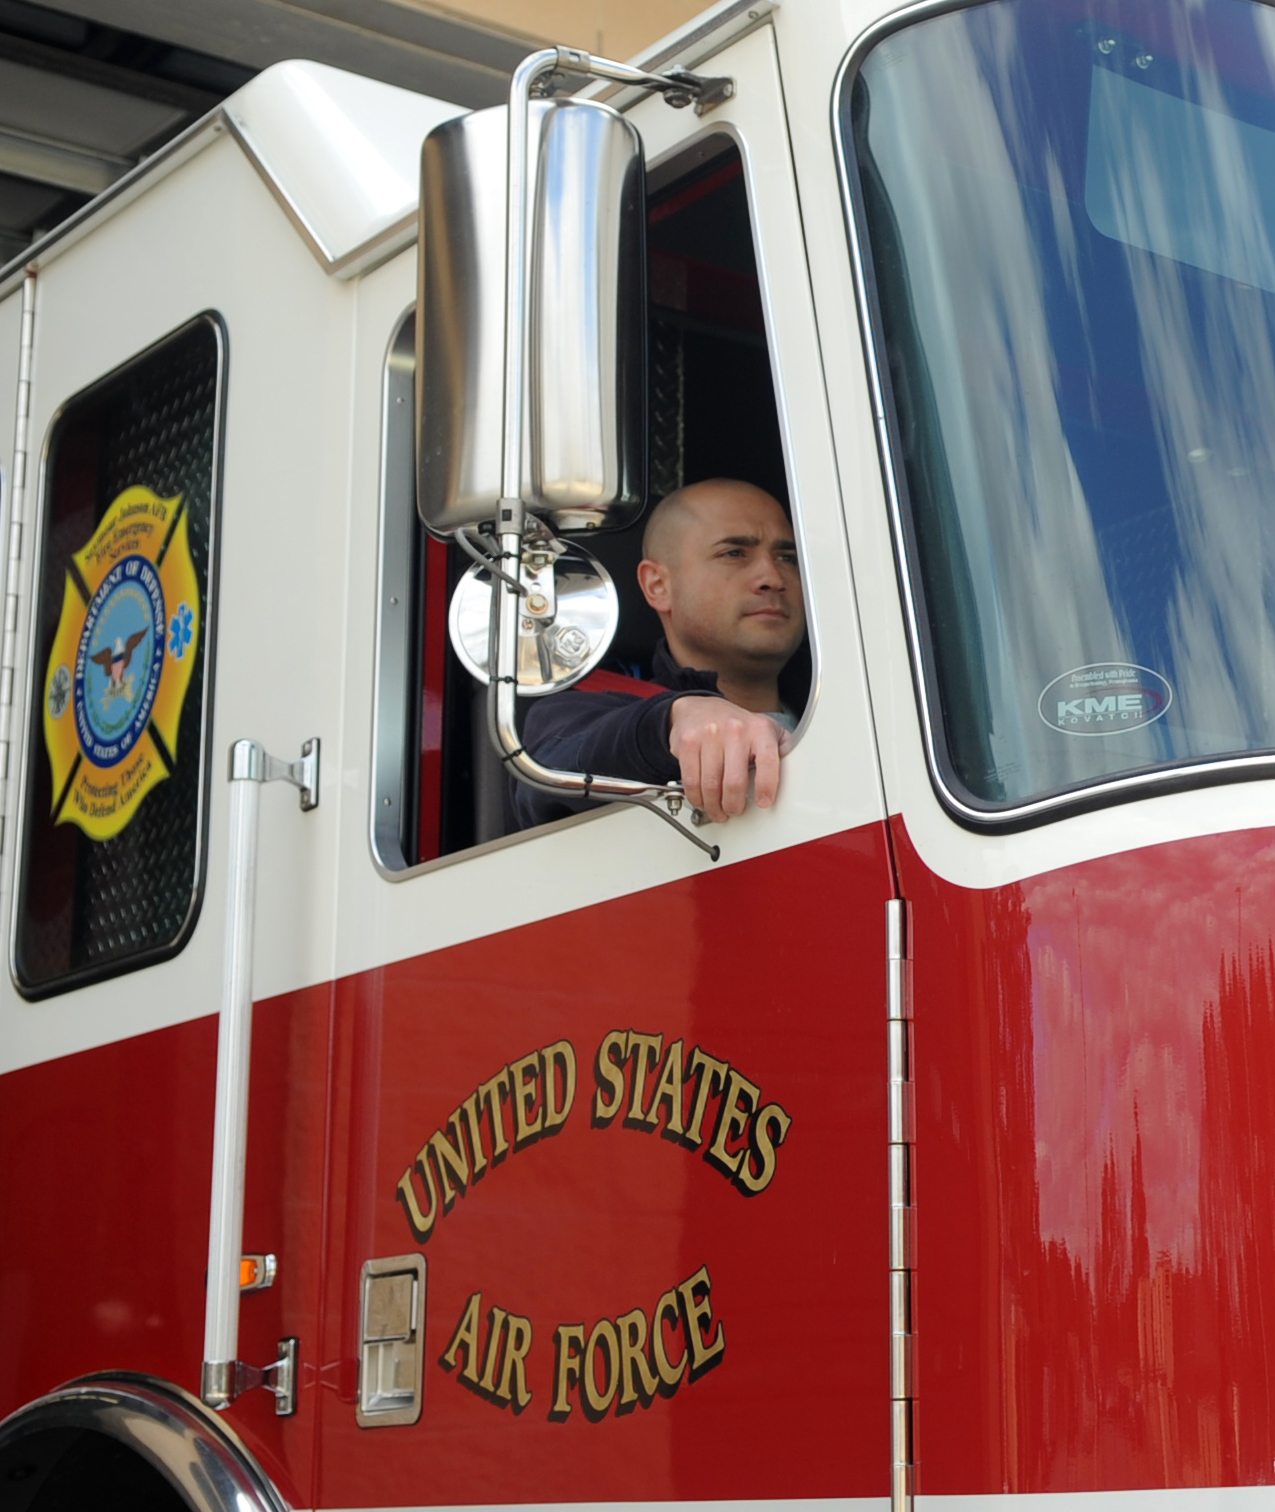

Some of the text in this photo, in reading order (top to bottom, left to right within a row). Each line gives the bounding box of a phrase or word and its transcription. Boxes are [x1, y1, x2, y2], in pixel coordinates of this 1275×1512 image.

[113, 522, 154, 540] Emergency
[75, 559, 165, 679] DEPARTMENT OF DEFENSE
[76, 661, 161, 759] UNITED STATES OF AMERICA
[1057, 694, 1142, 717] KME
[1057, 710, 1143, 727] KOVATCH
[81, 774, 118, 797] Protecting
[89, 798, 116, 818] Defend
[120, 761, 151, 806] America
[397, 1027, 793, 1244] UNITED STATES
[438, 1264, 726, 1423] AIR FORCE
